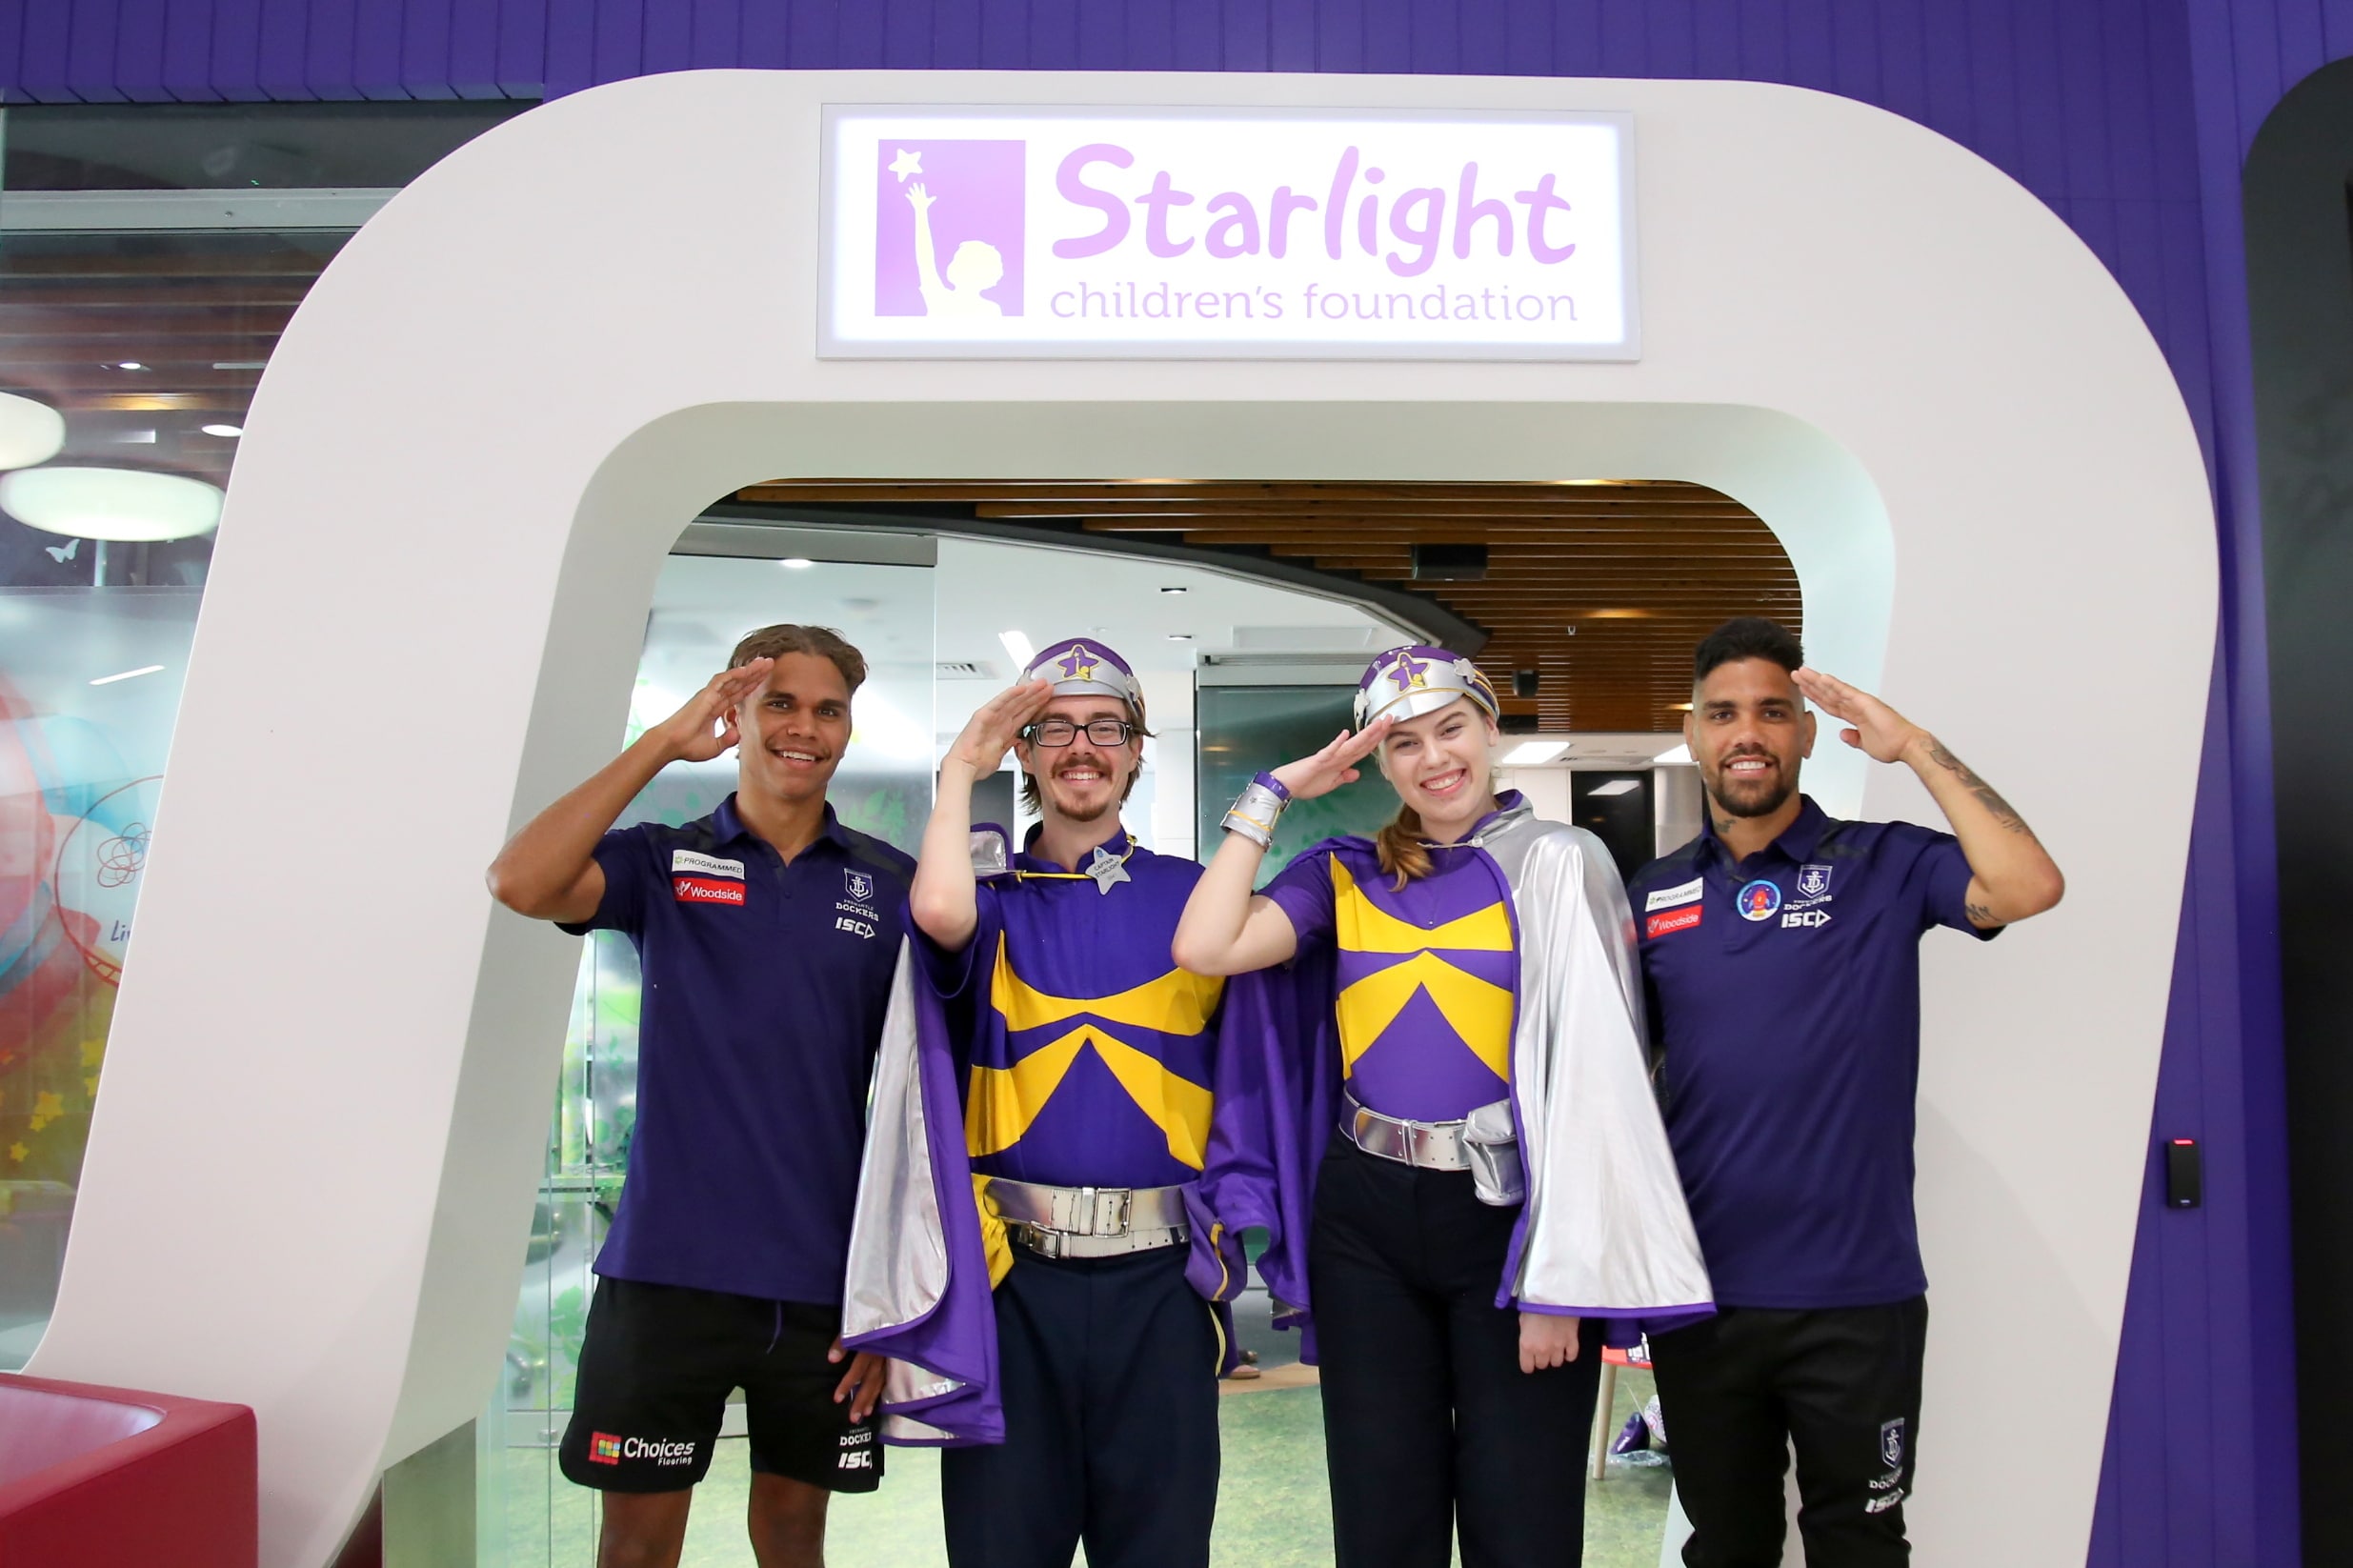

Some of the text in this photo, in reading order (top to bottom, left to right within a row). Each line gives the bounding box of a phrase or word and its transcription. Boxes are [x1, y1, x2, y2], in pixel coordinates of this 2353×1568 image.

[1051, 142, 1578, 278] Starlight
[1050, 281, 1579, 321] children's foundation
[683, 856, 743, 874] PROGRAMMED
[690, 886, 743, 902] Woodside
[835, 901, 880, 922] DOCKERS
[1780, 911, 1816, 929] ISC
[835, 916, 867, 935] ISC
[1659, 914, 1699, 931] Woodside
[623, 1437, 695, 1458] Choices
[657, 1456, 693, 1466] Flooring
[838, 1450, 871, 1469] ISC
